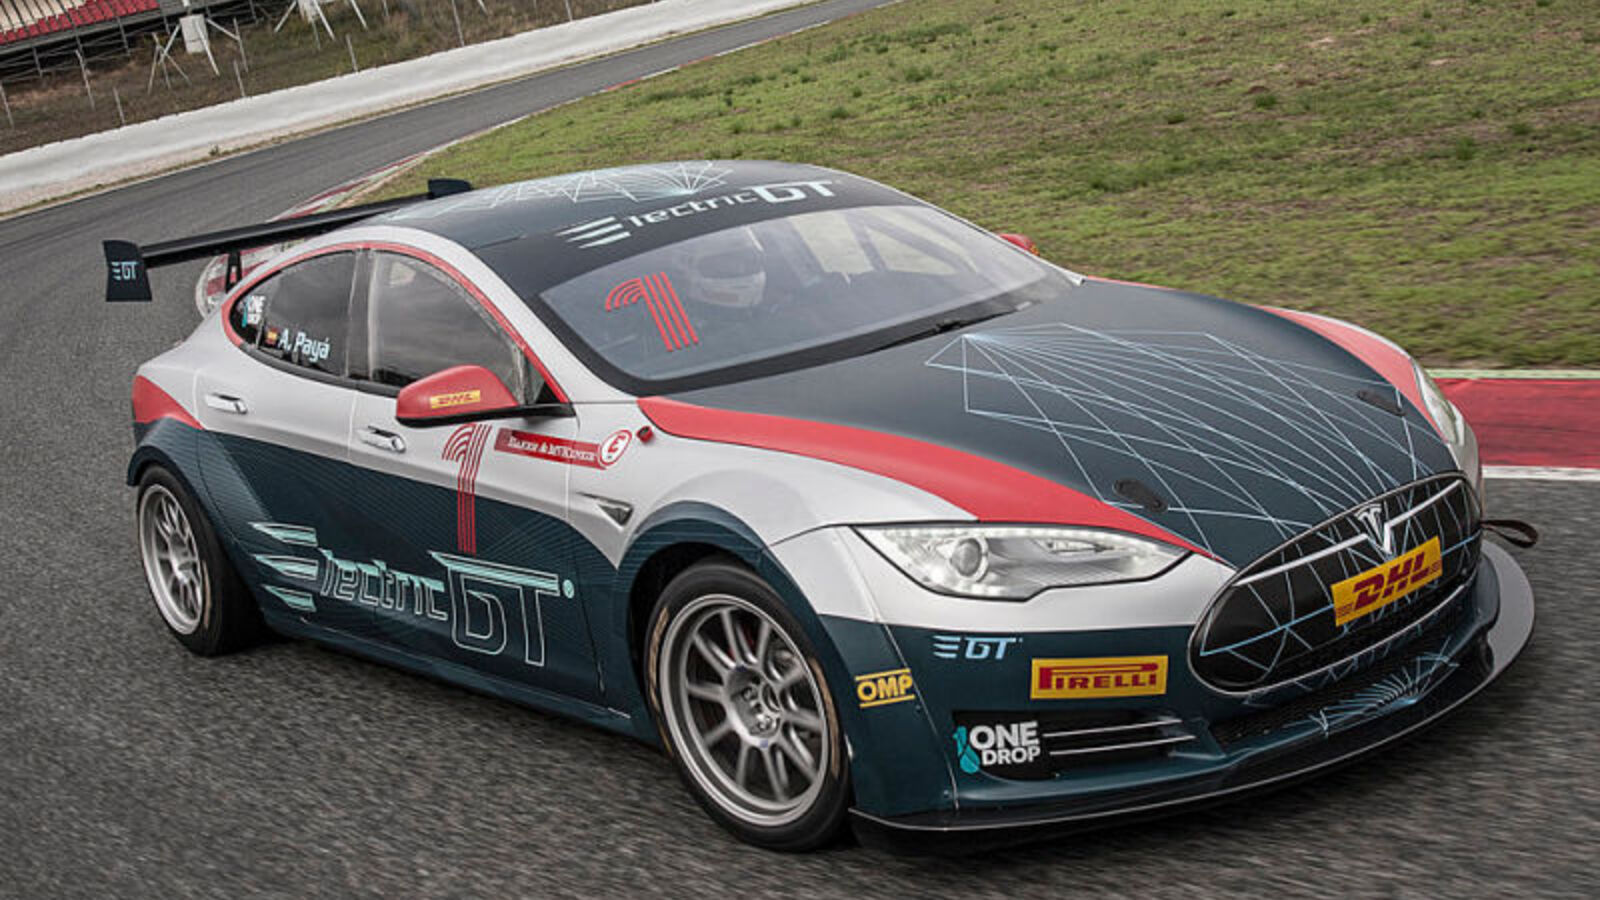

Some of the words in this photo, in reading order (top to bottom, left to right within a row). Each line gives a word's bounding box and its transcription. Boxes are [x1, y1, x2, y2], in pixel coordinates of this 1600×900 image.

[293, 332, 330, 363] Payá
[1352, 551, 1431, 611] DHL
[856, 674, 914, 702] OMP
[1038, 662, 1160, 691] PIRELLI
[968, 720, 1041, 750] ONE
[981, 744, 1042, 767] DROP
